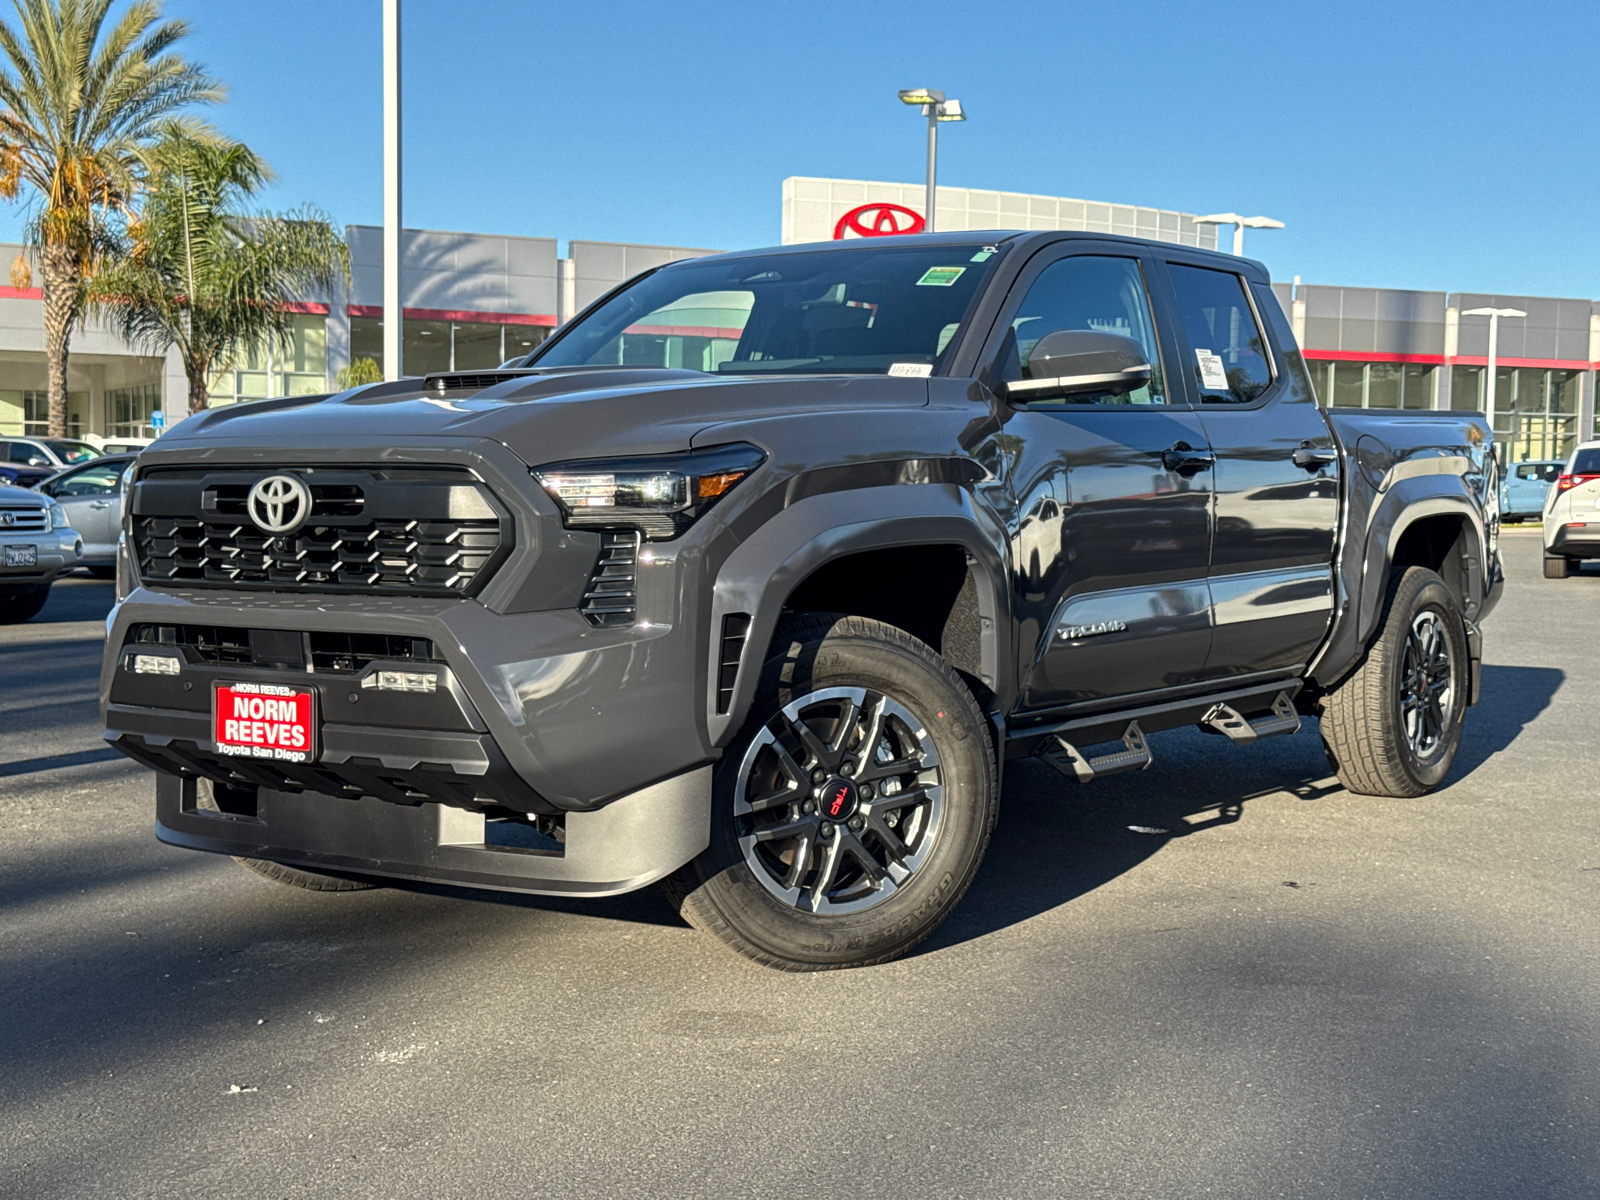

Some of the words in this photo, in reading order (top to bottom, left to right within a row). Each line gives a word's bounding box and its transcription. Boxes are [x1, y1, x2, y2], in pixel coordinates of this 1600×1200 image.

[1057, 620, 1127, 639] TACOMA
[236, 683, 260, 694] NORM
[260, 685, 290, 696] REEVES
[233, 697, 297, 722] NORM
[225, 719, 305, 747] REEVES
[217, 742, 251, 756] Toyota
[252, 746, 273, 758] San
[274, 748, 306, 762] Diego
